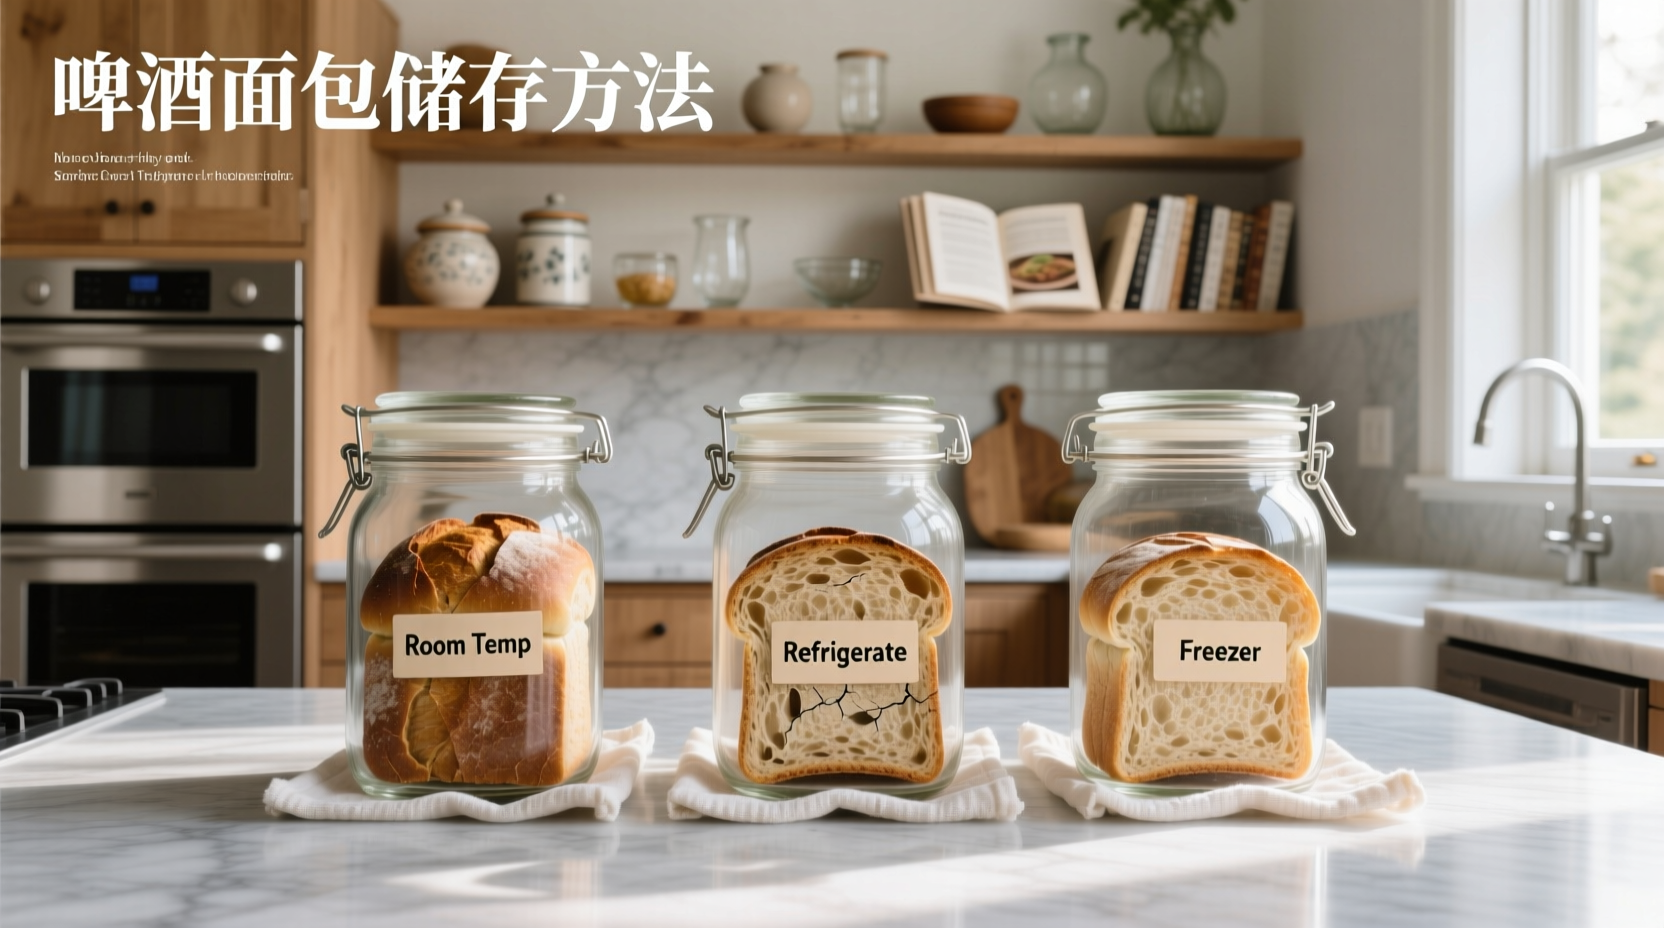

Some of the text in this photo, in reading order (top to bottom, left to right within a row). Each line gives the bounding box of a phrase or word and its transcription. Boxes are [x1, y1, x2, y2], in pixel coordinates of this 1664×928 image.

[405, 632, 533, 660] Room Temp
[784, 640, 908, 669] Refrigerate
[1180, 639, 1262, 663] Freezer
